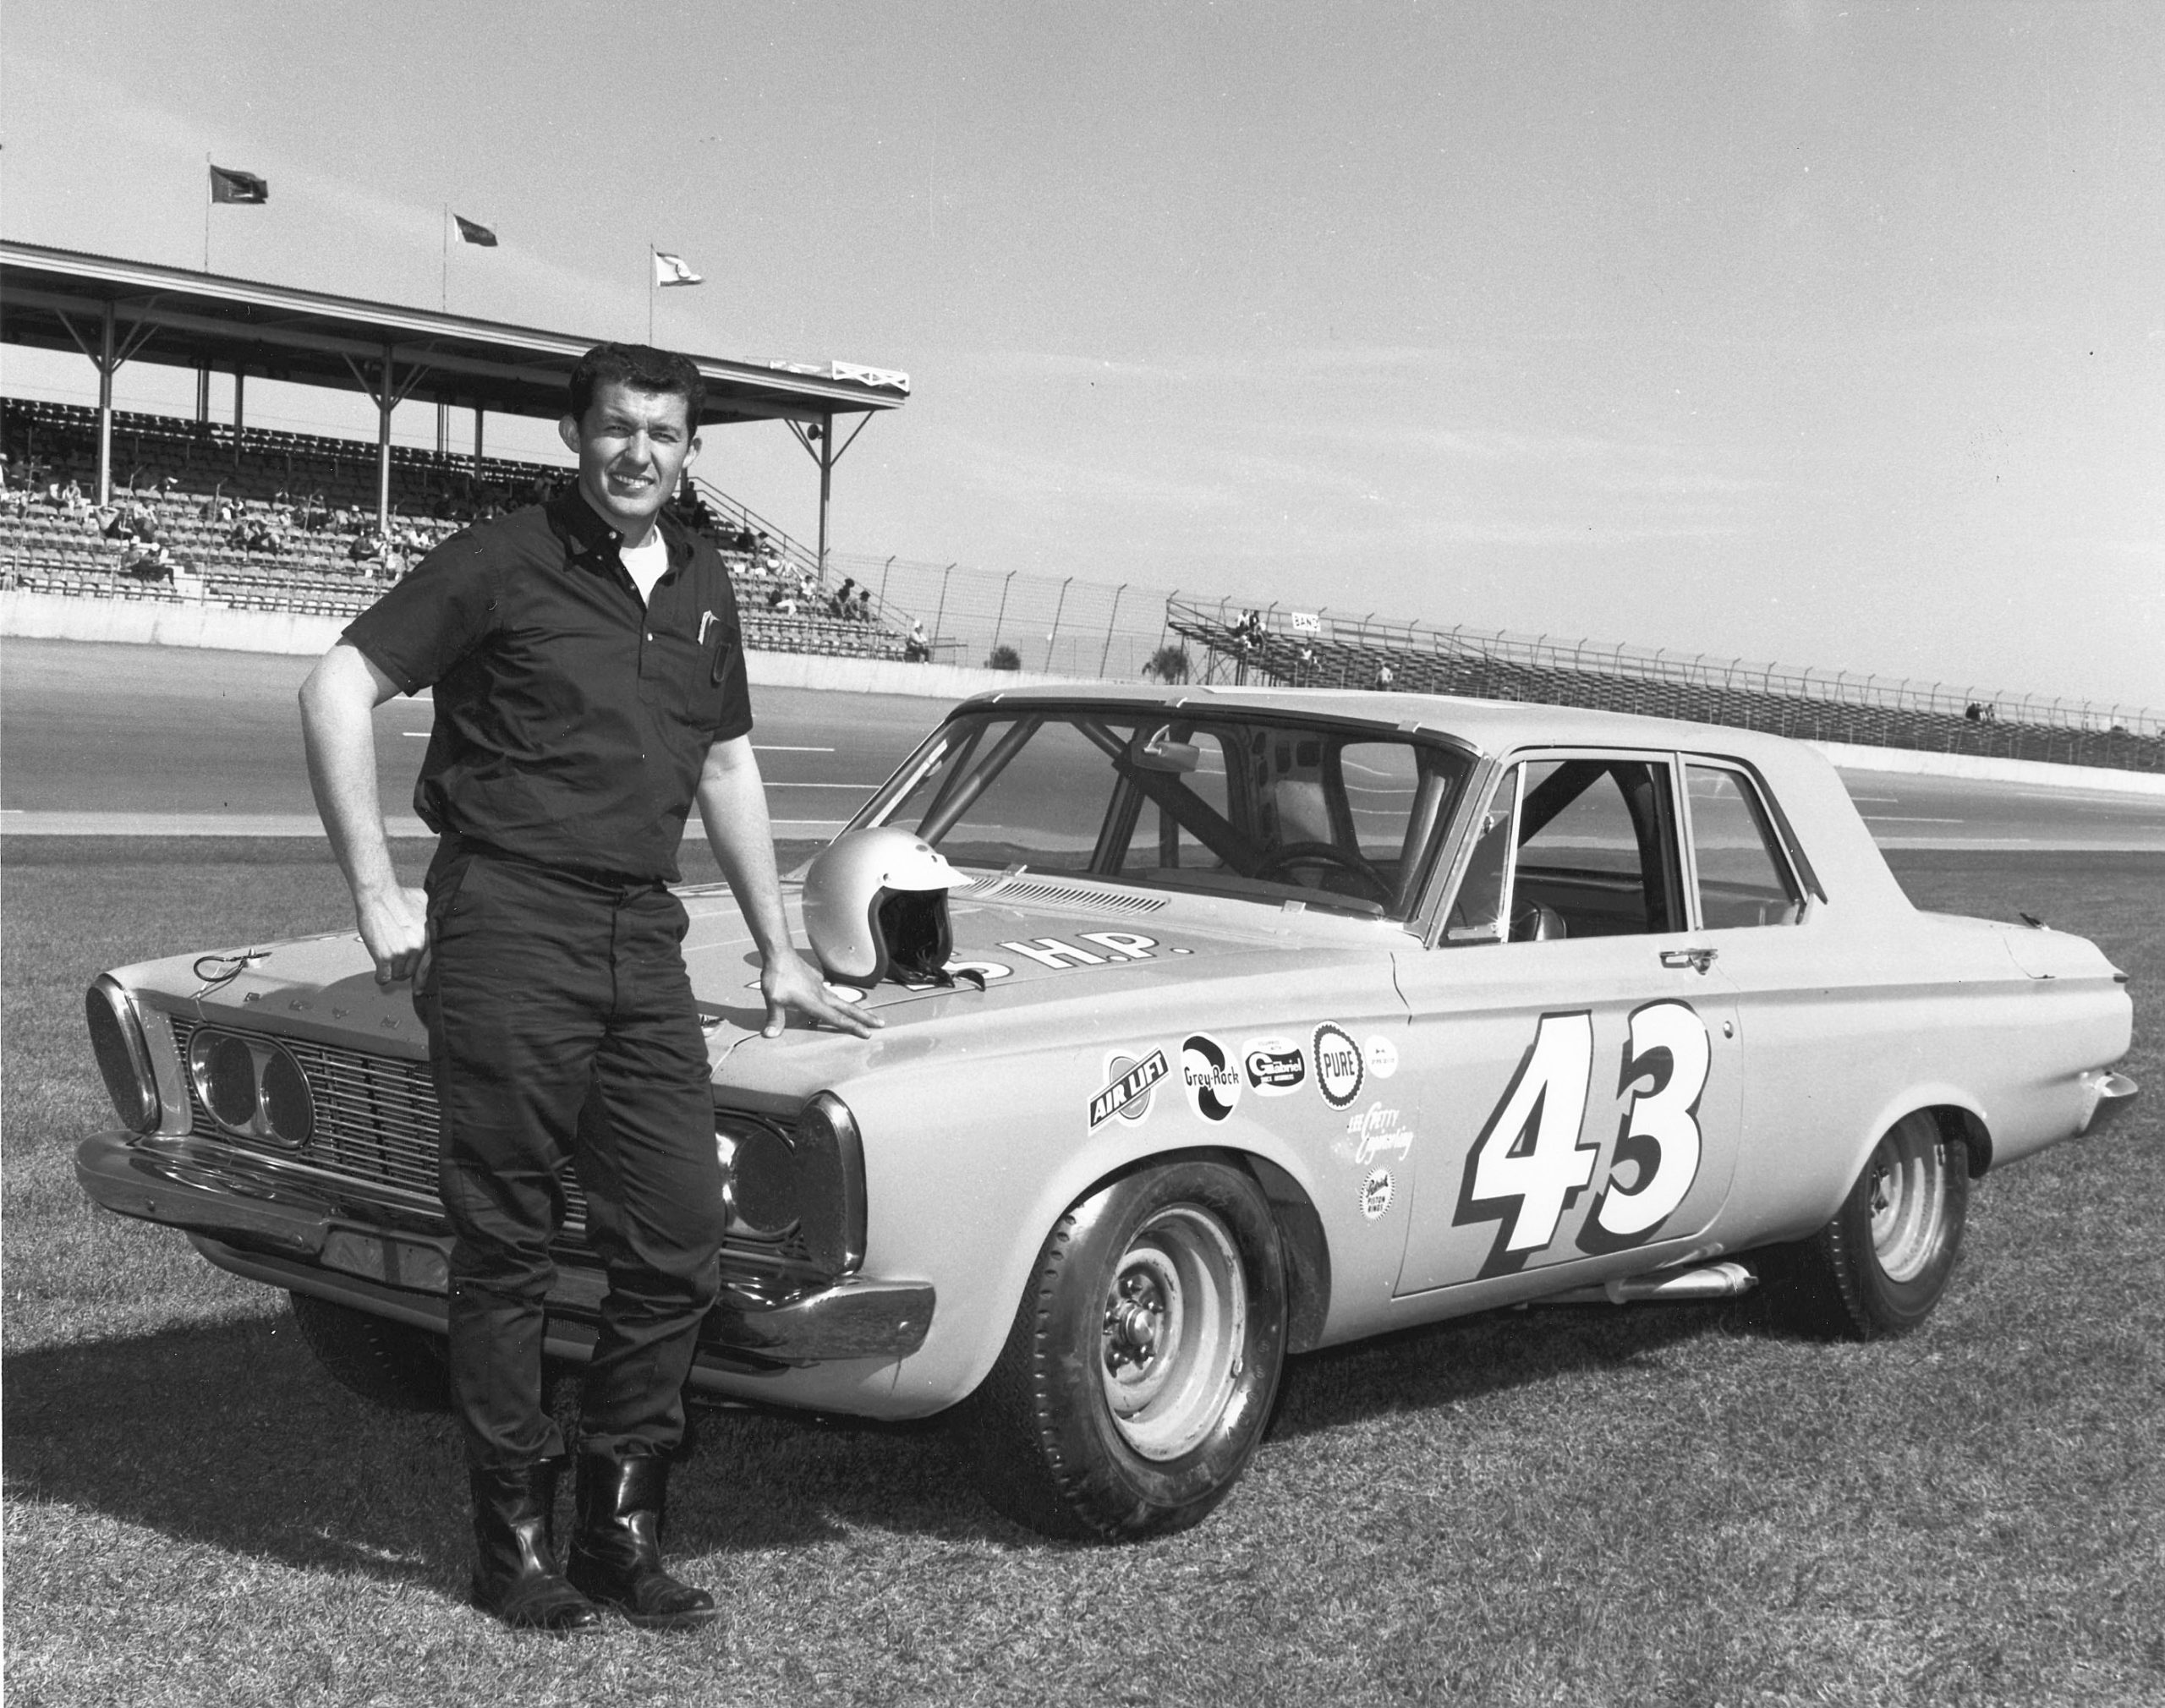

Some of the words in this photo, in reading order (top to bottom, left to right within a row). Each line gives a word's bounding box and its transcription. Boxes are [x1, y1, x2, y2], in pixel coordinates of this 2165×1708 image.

[1183, 1065, 1240, 1089] Grey-Rock
[1248, 1052, 1302, 1077] Gabriel
[1323, 1050, 1356, 1079] PURE
[1093, 1083, 1128, 1125] AIR
[1127, 1051, 1165, 1098] LIFT
[1461, 998, 1712, 1259] 43
